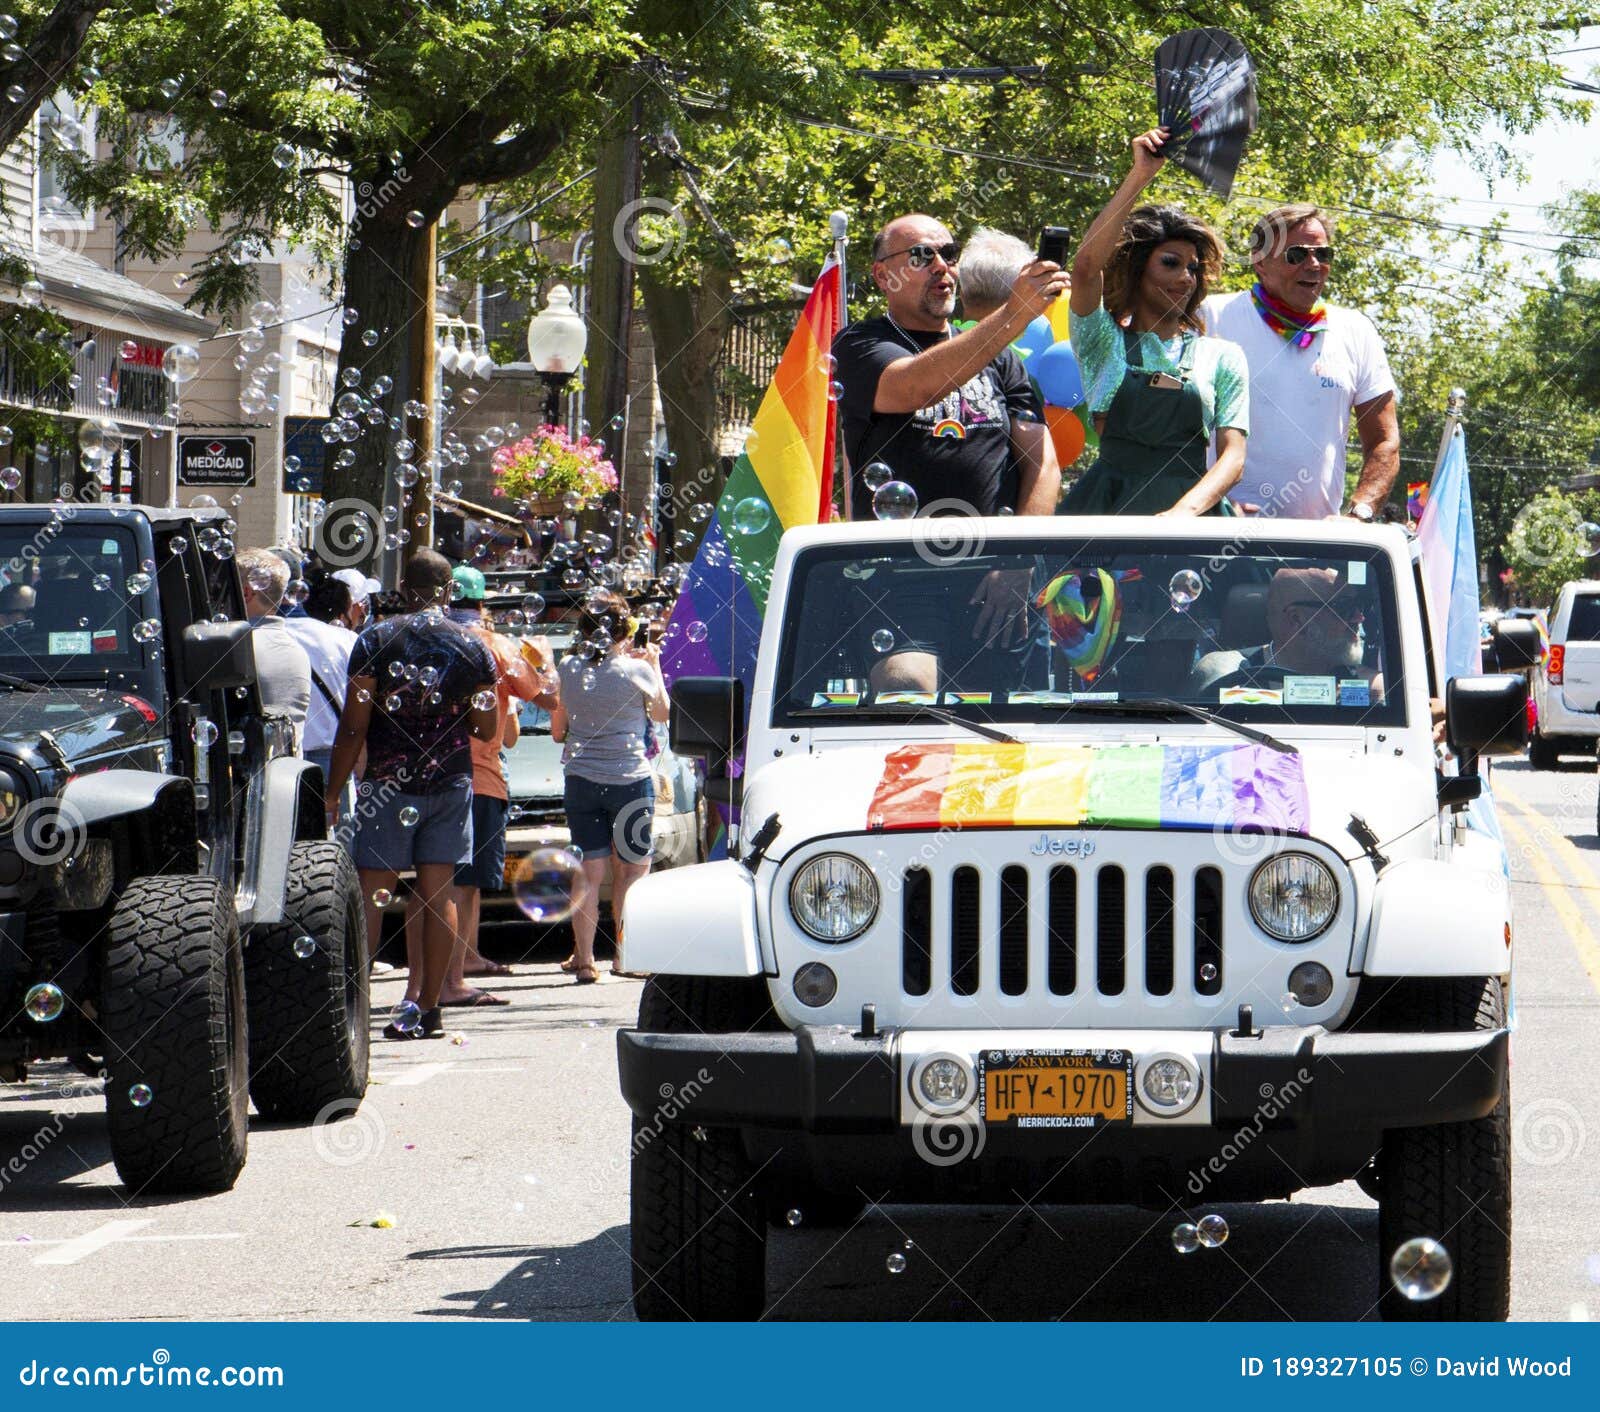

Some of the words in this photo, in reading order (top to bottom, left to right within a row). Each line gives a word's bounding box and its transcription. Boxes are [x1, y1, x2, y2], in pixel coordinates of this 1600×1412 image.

[187, 456, 244, 469] MEDICAID
[1031, 834, 1096, 859] Jeep
[1019, 1057, 1052, 1068] NEW
[1056, 1057, 1094, 1068] YORK
[995, 1074, 1038, 1109] HFY
[1058, 1074, 1116, 1109] 1970
[1017, 1117, 1095, 1128] MERRICKDCJ.COM
